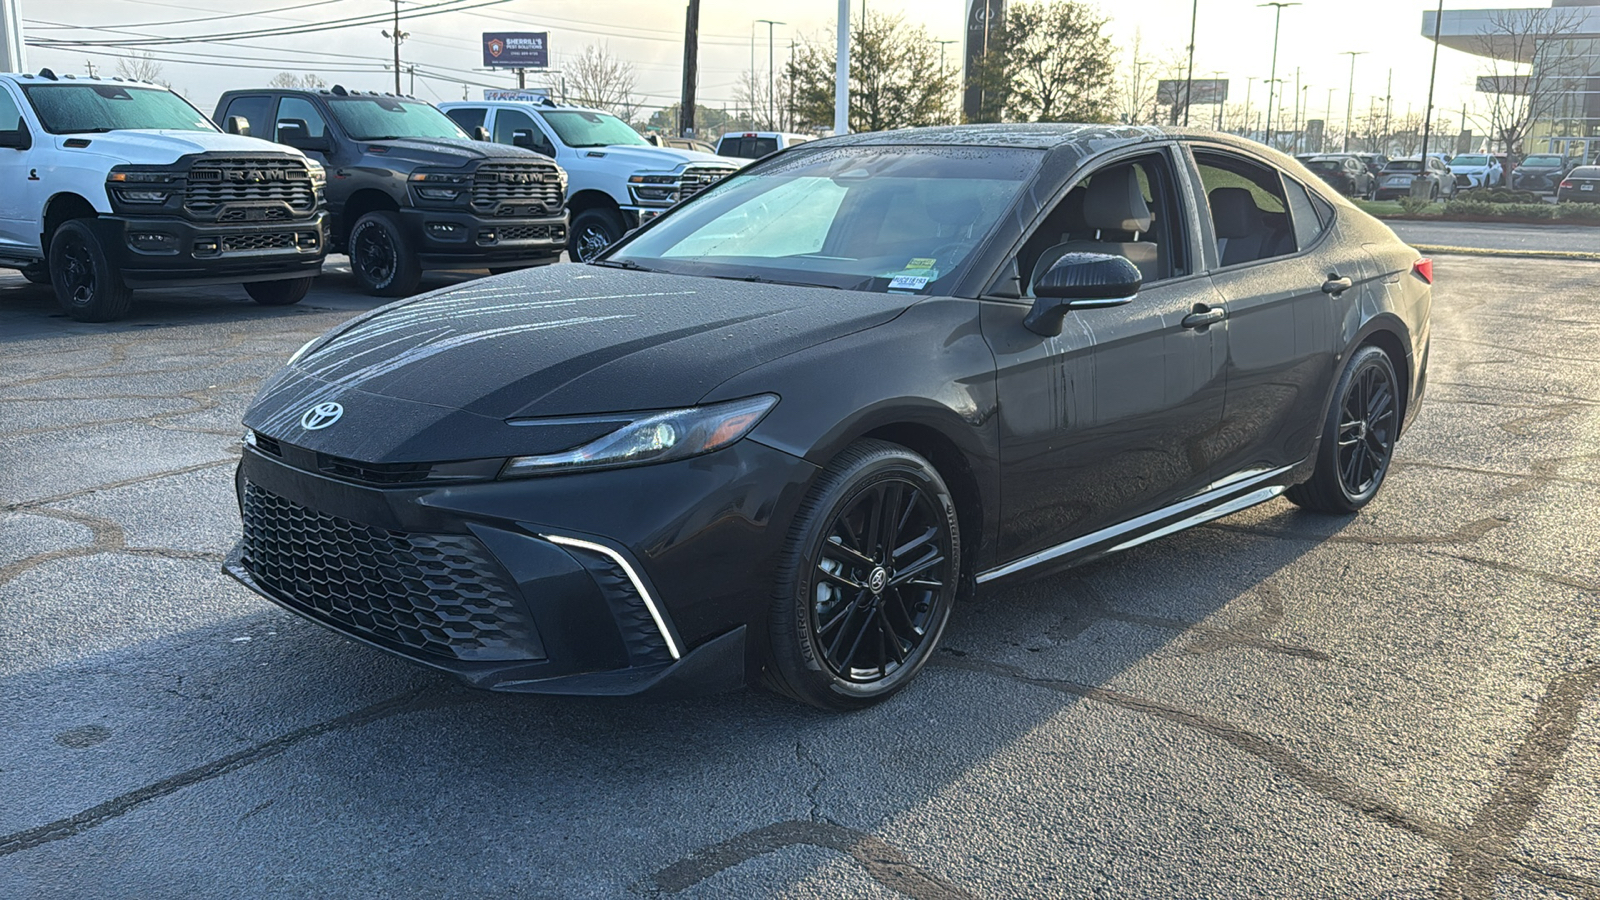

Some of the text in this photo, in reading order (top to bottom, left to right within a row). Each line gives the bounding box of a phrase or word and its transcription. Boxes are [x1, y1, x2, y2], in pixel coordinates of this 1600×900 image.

[223, 169, 284, 180] RAM
[500, 173, 543, 182] RAM
[796, 596, 815, 663] KINERGY
